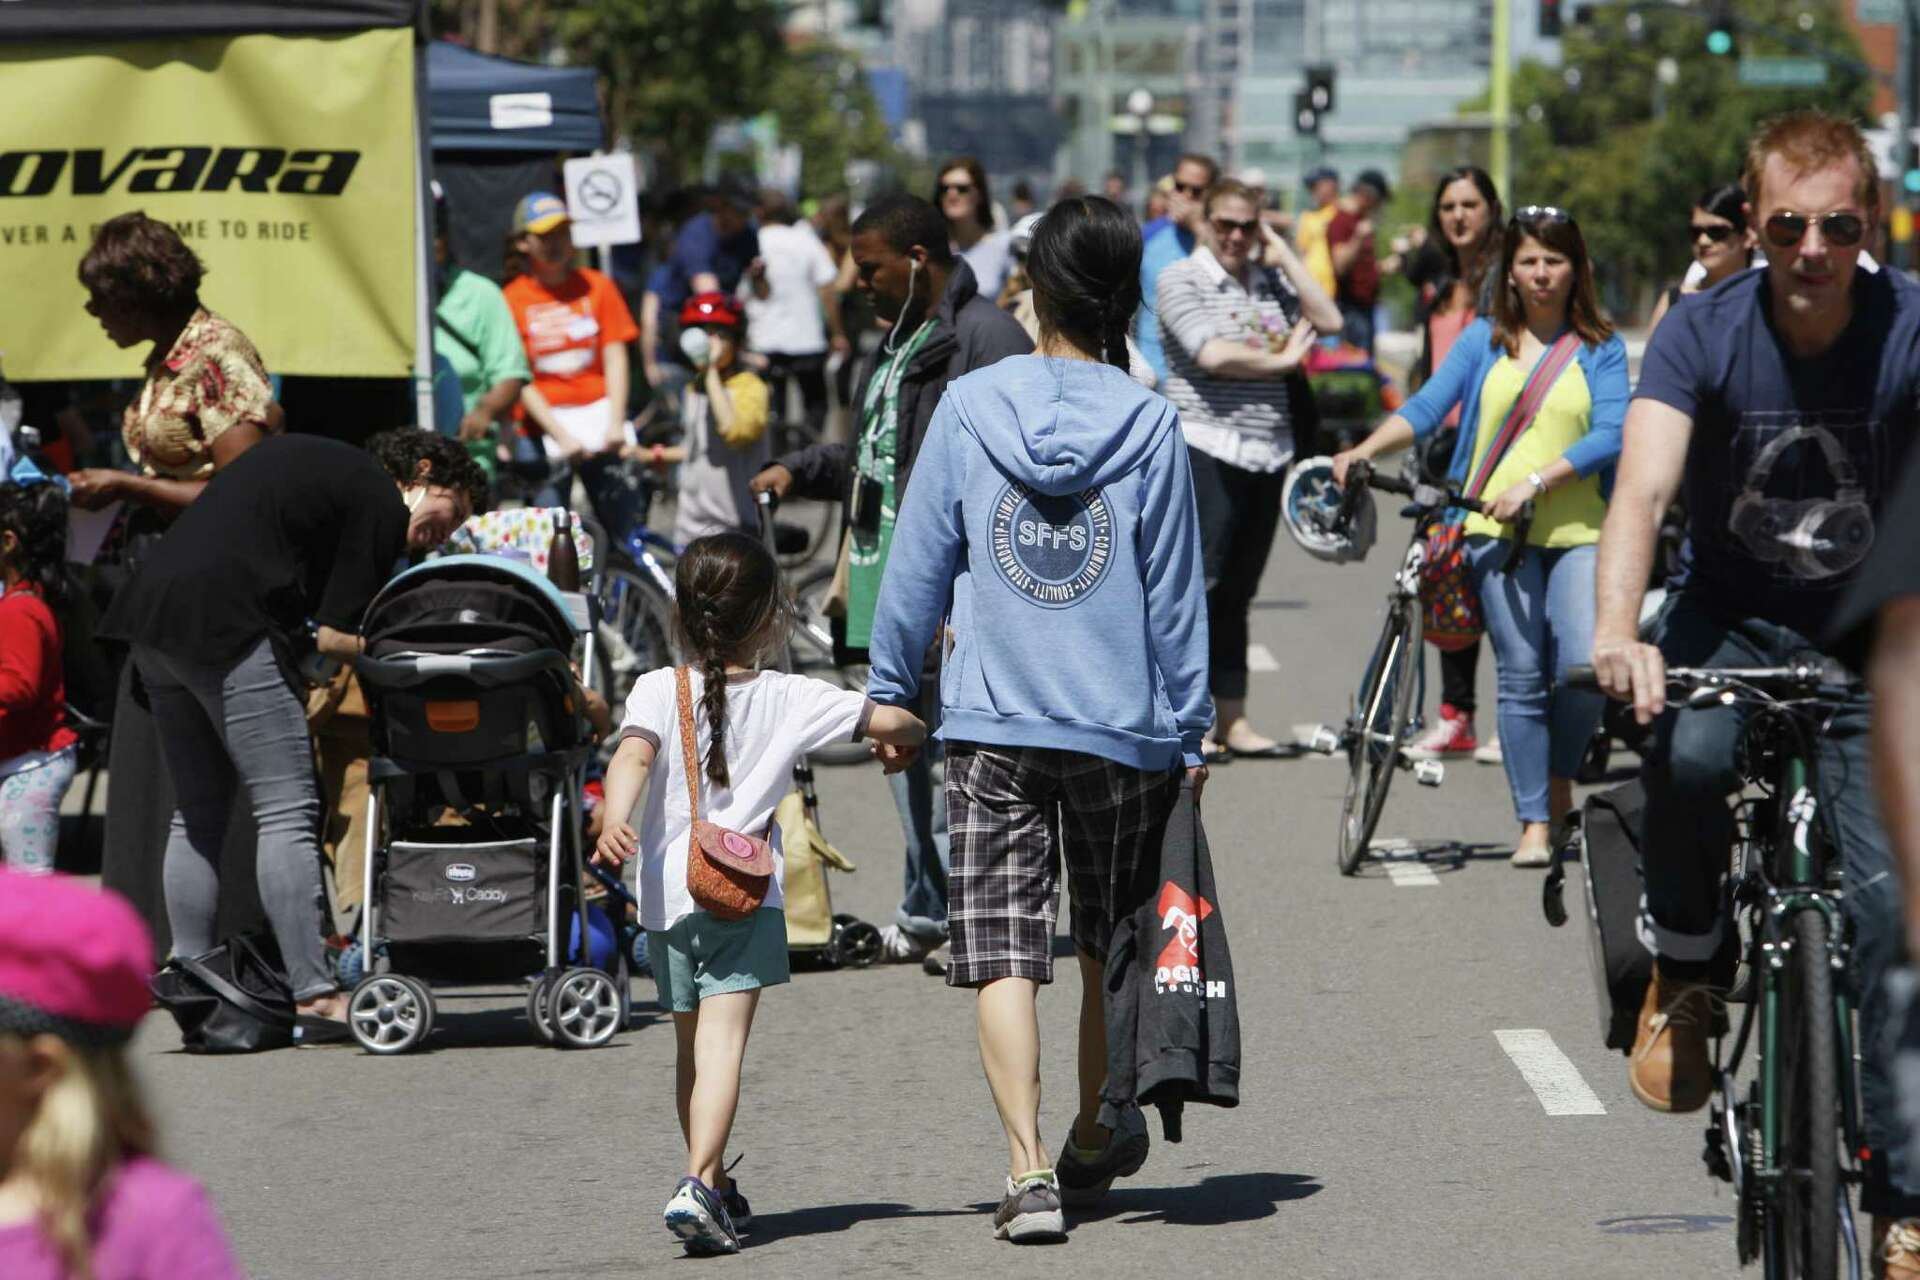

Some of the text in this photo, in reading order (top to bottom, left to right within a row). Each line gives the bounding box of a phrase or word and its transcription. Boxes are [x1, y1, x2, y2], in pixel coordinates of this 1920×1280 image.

[61, 223, 76, 243] A
[175, 220, 208, 240] ME
[219, 220, 248, 239] TO
[257, 221, 311, 241] RIDE
[1018, 520, 1087, 551] SFFS
